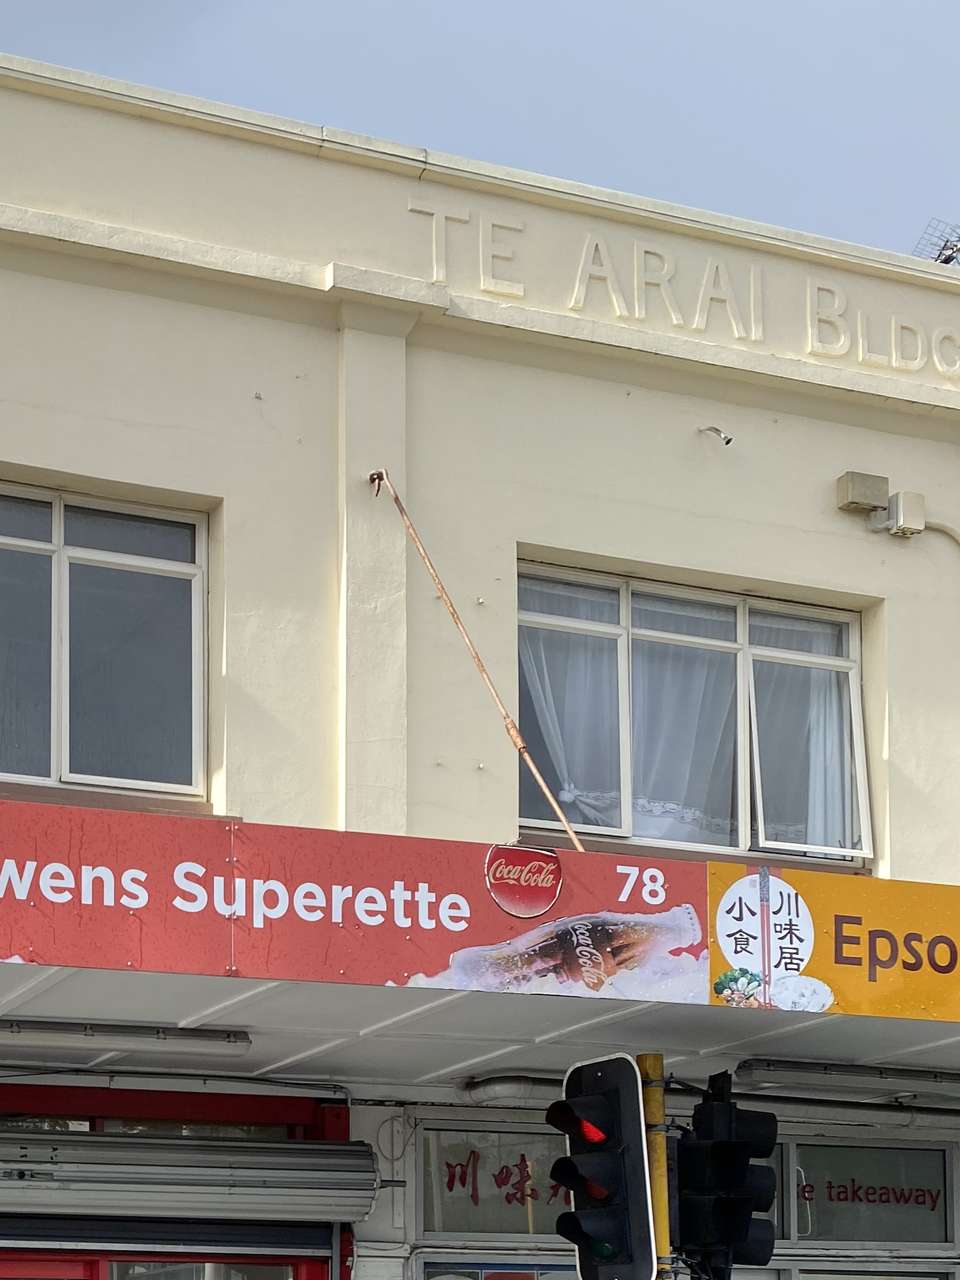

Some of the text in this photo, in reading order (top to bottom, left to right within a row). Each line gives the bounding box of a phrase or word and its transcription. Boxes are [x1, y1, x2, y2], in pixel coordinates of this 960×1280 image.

[408, 197, 525, 297] TE
[568, 233, 764, 341] ARAI
[172, 861, 472, 932] Superette
[616, 865, 666, 905] 78
[725, 896, 758, 955] 小食
[772, 890, 806, 973] 川味居
[833, 913, 959, 983] Epso
[826, 1178, 941, 1212] takeaway
